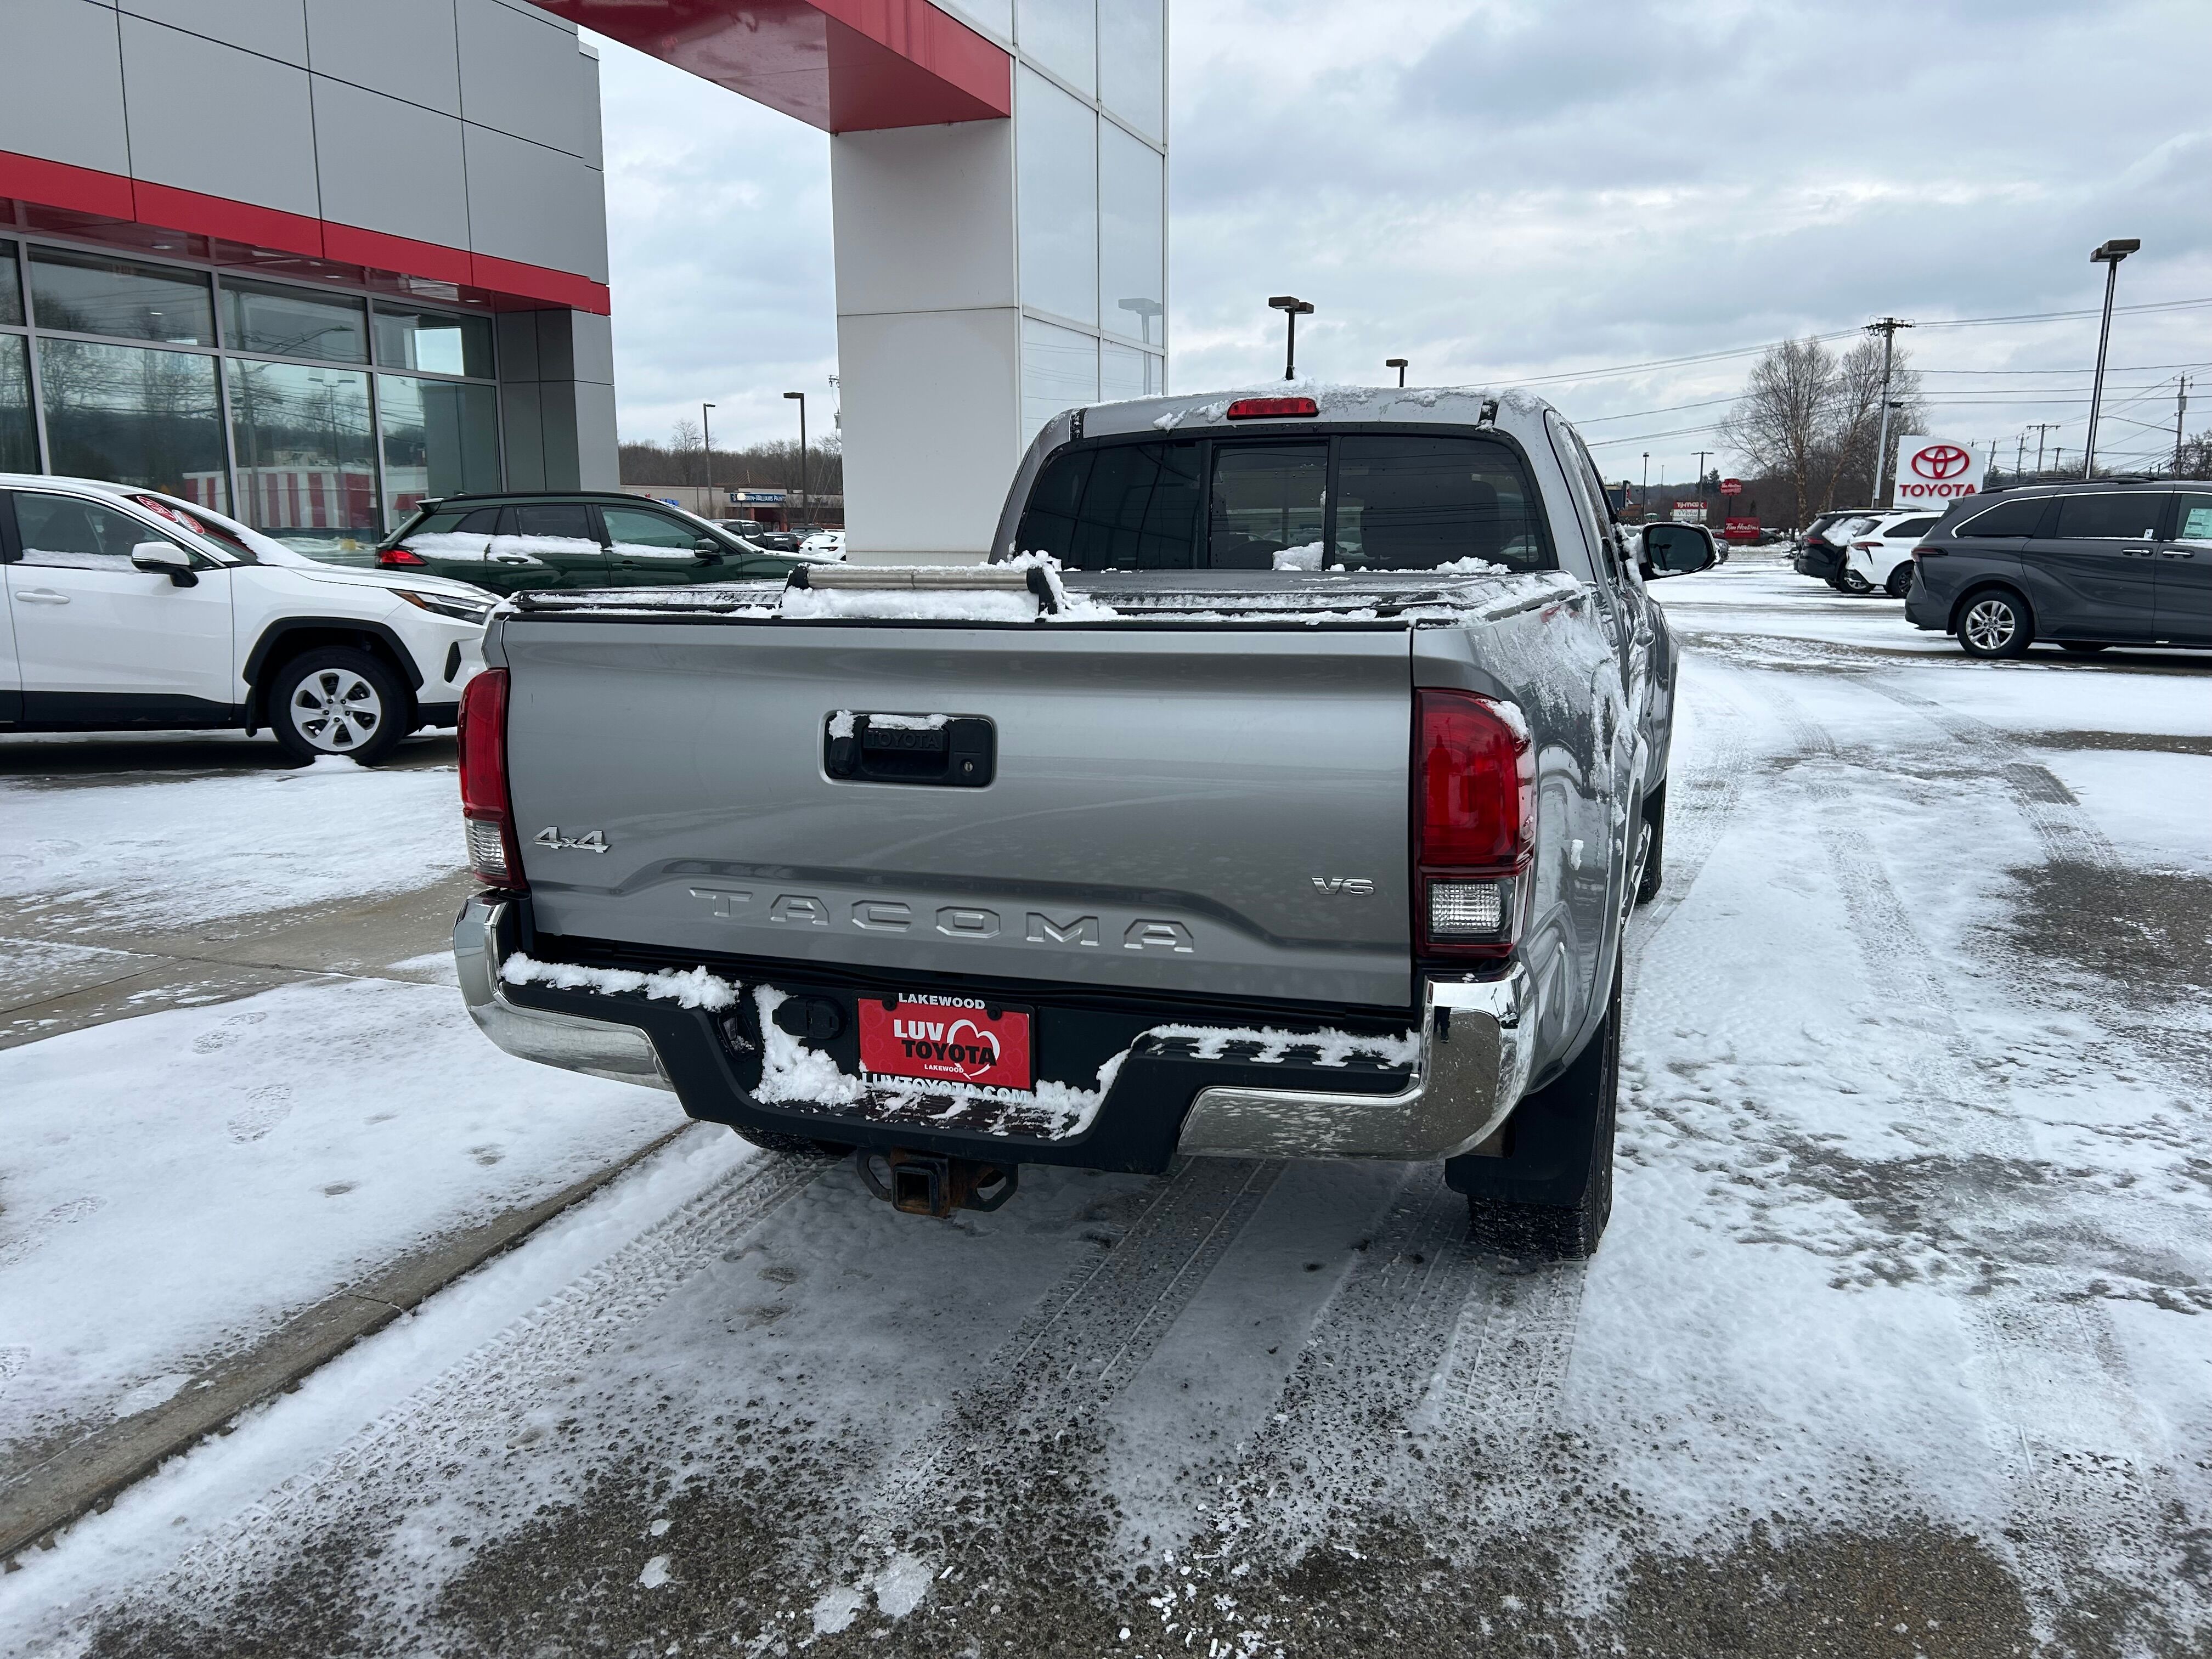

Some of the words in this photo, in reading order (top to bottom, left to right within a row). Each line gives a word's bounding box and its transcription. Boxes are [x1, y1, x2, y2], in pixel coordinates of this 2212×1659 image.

[1899, 484, 1976, 497] TOYOTA
[1736, 522, 1759, 531] Hortons
[868, 732, 940, 749] TOYOTA
[533, 826, 611, 853] 4x4
[1311, 877, 1375, 896] V6
[689, 887, 1194, 953] TACOMA
[898, 993, 985, 1009] LAKEWOOD
[894, 1019, 944, 1041] LUV
[901, 1039, 997, 1066] TOYOTA
[924, 1064, 964, 1074] LAKEWOOD
[862, 1073, 1028, 1102] LUVTOYOTACOM
